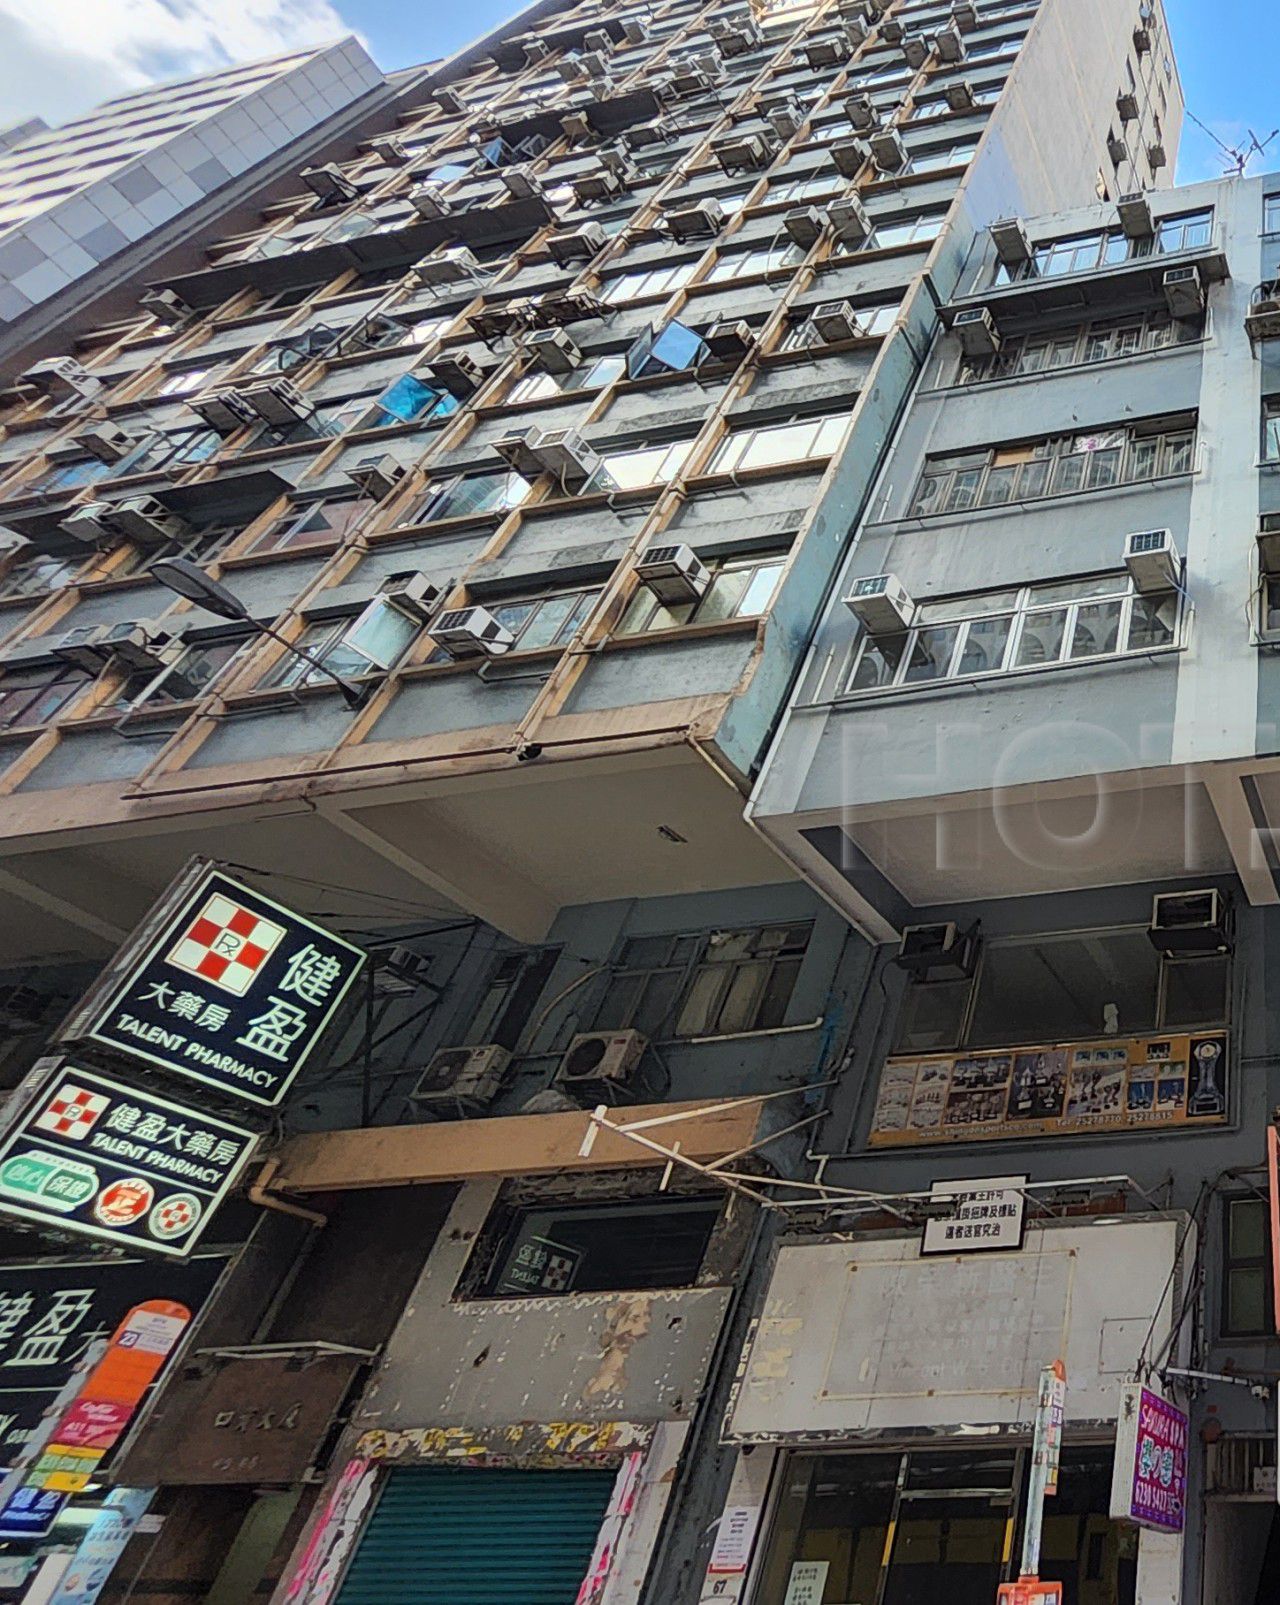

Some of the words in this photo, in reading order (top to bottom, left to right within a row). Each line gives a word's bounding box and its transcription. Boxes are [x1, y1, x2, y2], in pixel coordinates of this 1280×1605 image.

[137, 981, 232, 1033] 大藥房
[235, 943, 342, 1063] 健盈
[117, 1013, 187, 1052] TALENT
[183, 1042, 280, 1090] PHARMACY
[90, 1132, 149, 1162] TALENT
[145, 1148, 224, 1185] PHARMACY
[105, 1102, 241, 1166] 健盈大藥房
[712, 1579, 728, 1595] 67
